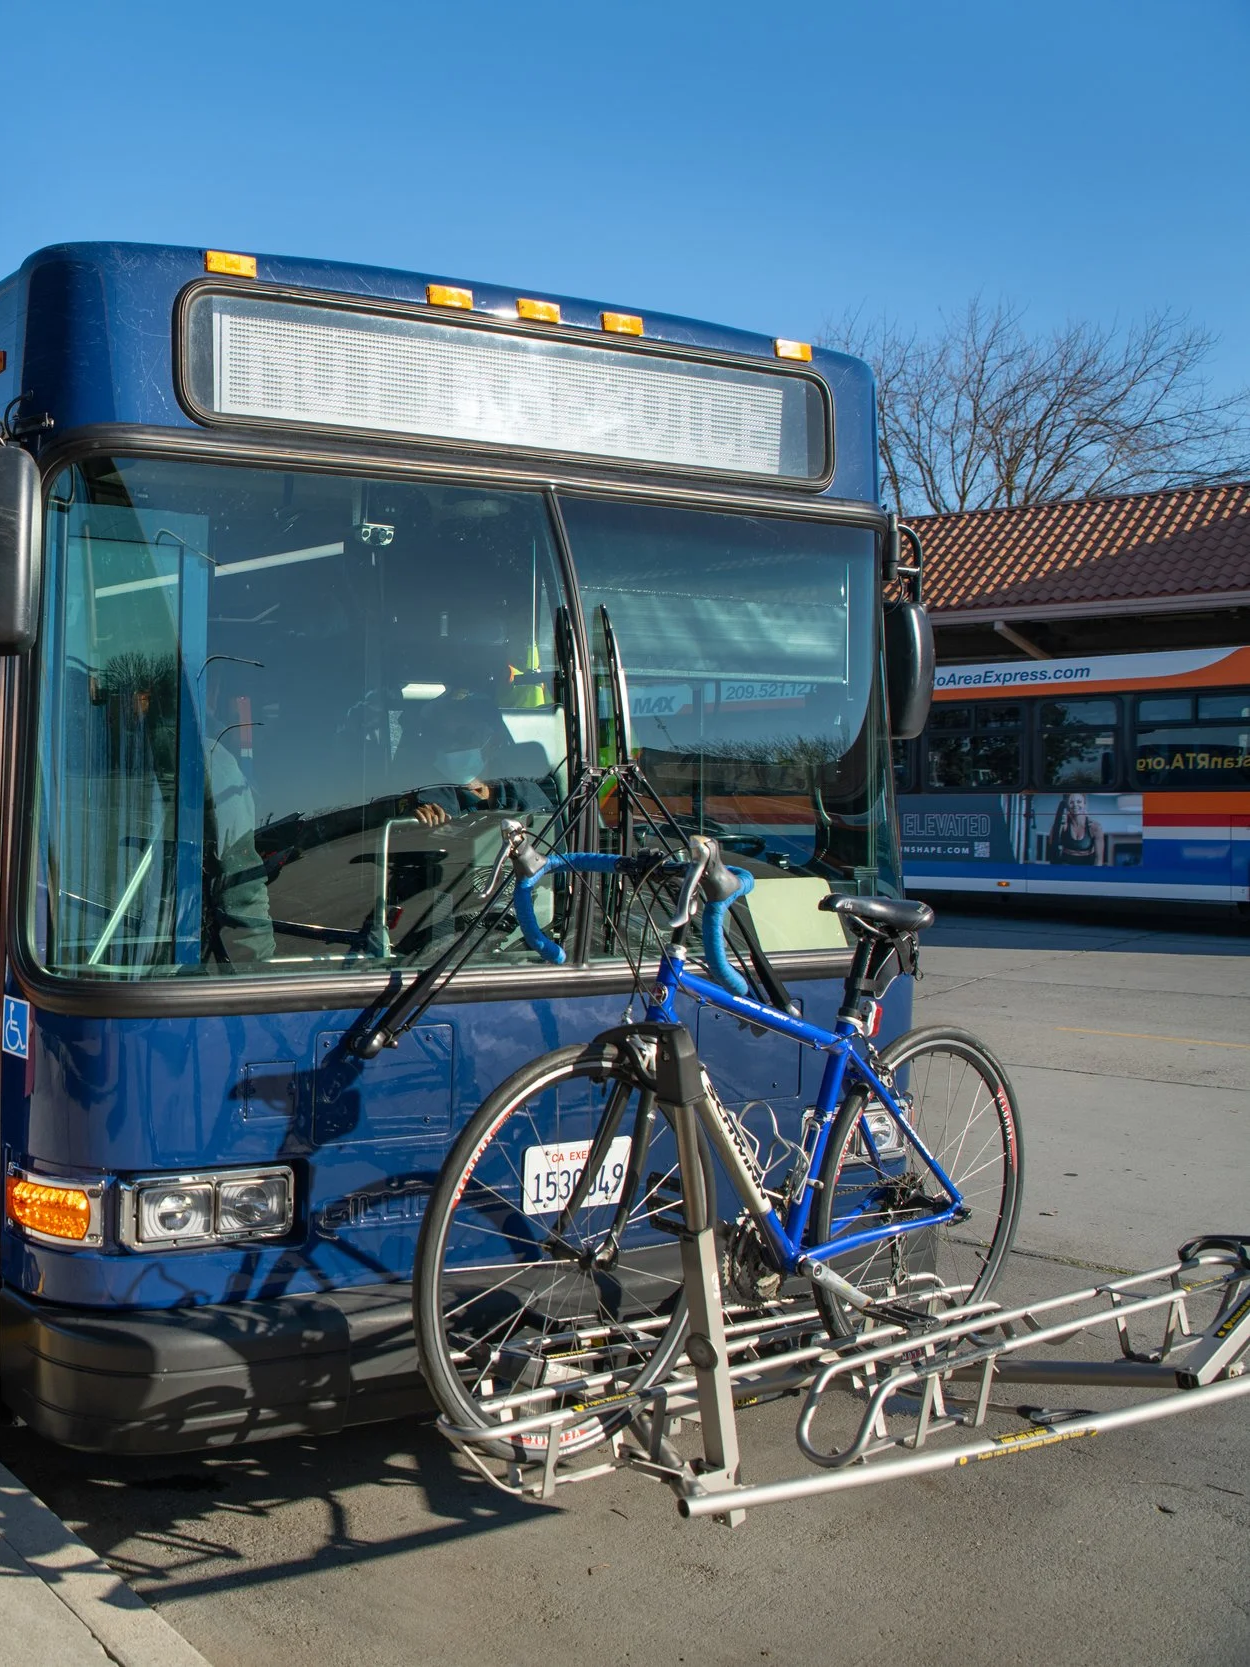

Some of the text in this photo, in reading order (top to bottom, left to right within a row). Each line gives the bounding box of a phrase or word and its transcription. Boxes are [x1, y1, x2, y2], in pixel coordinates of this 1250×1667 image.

[633, 695, 676, 714] MAX
[903, 813, 991, 837] ELEVATED
[706, 1083, 767, 1200] SCHWINN
[552, 1150, 591, 1163] CA EXE
[531, 1428, 581, 1446] VELAX
